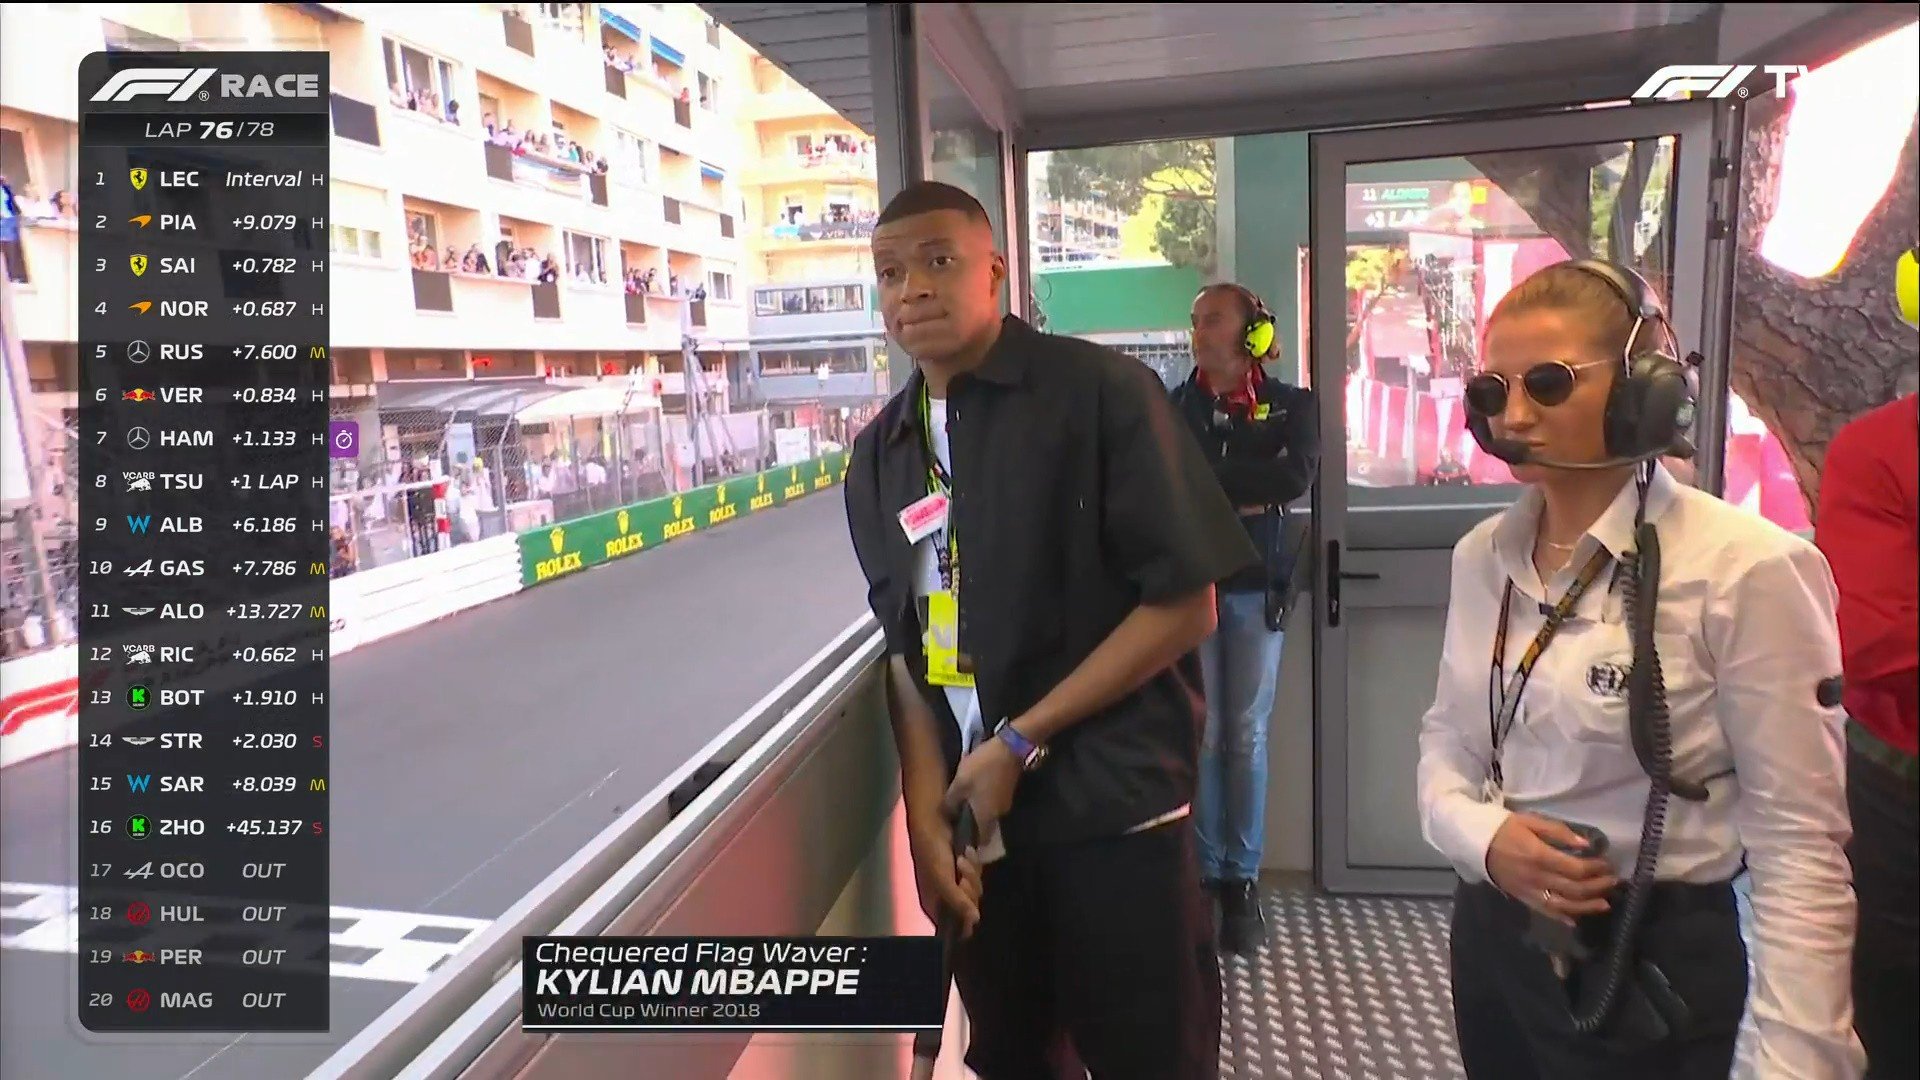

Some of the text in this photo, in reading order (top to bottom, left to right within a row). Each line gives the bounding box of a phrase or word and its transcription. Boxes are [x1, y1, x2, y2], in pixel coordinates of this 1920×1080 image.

[709, 503, 736, 525] ROLEX
[664, 516, 695, 539] ROLEX
[606, 532, 643, 558] ROLEX
[536, 551, 582, 580] ROLEX
